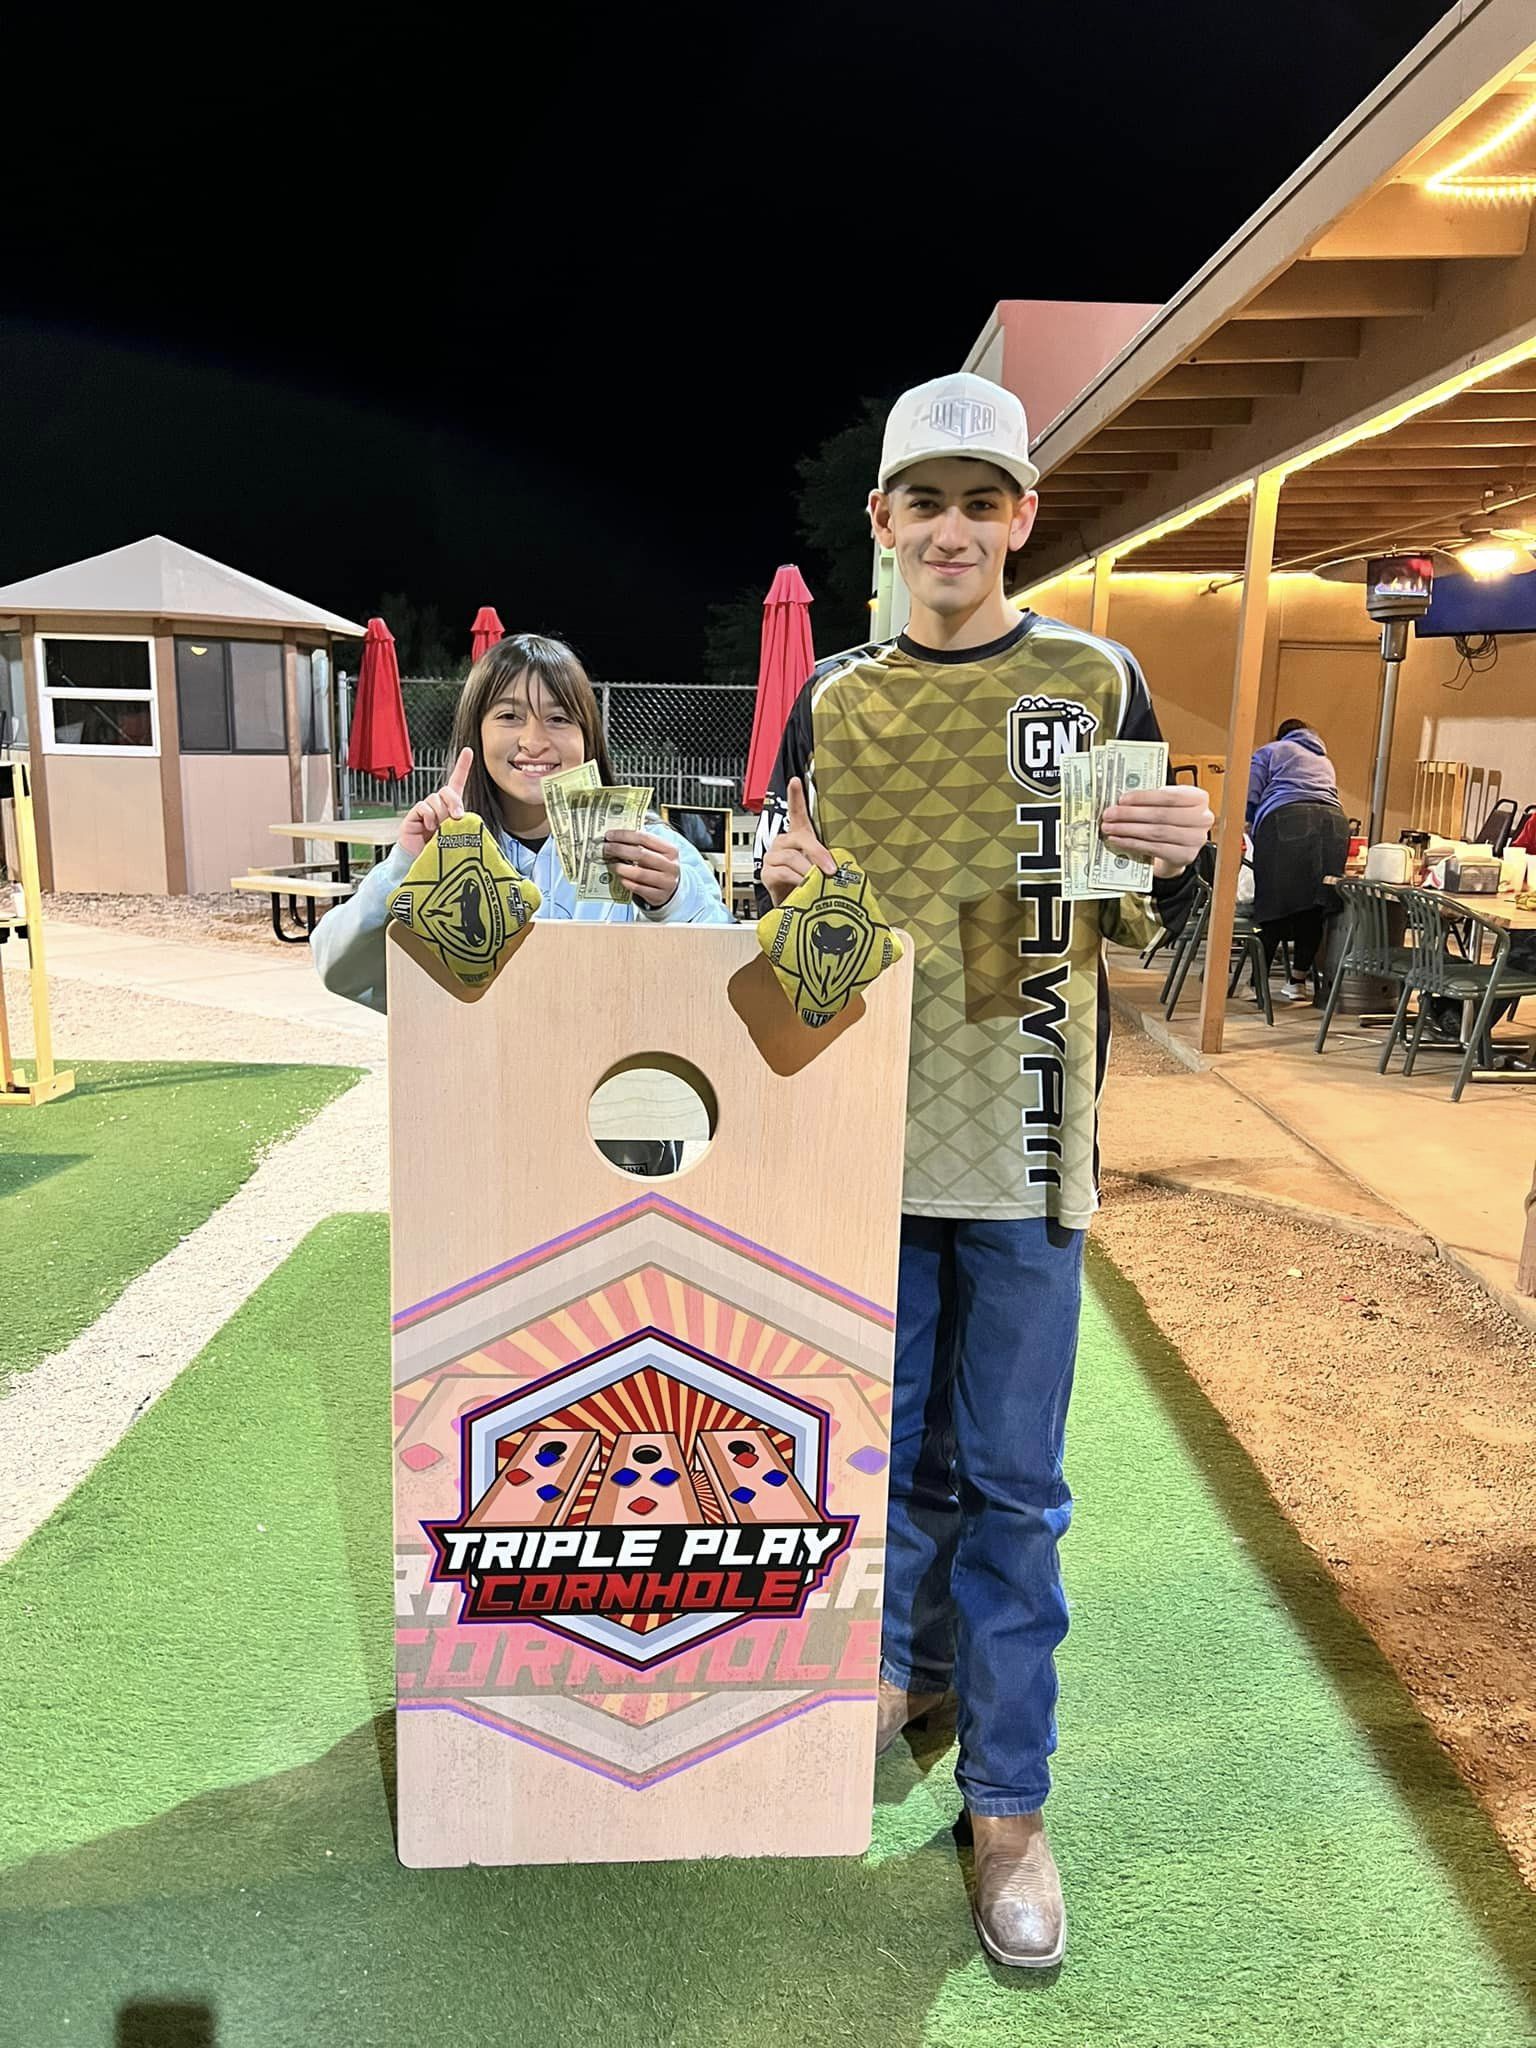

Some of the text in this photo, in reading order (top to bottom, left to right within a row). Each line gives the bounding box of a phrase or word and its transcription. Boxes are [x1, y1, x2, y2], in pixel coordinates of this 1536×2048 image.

[931, 401, 994, 438] ULTRA
[1025, 720, 1077, 767] GN
[1032, 770, 1044, 778] GET
[1016, 803, 1073, 1190] HAWAII
[443, 1527, 842, 1570] TRIPLE PLAY
[477, 1570, 802, 1612] CORNHOLE
